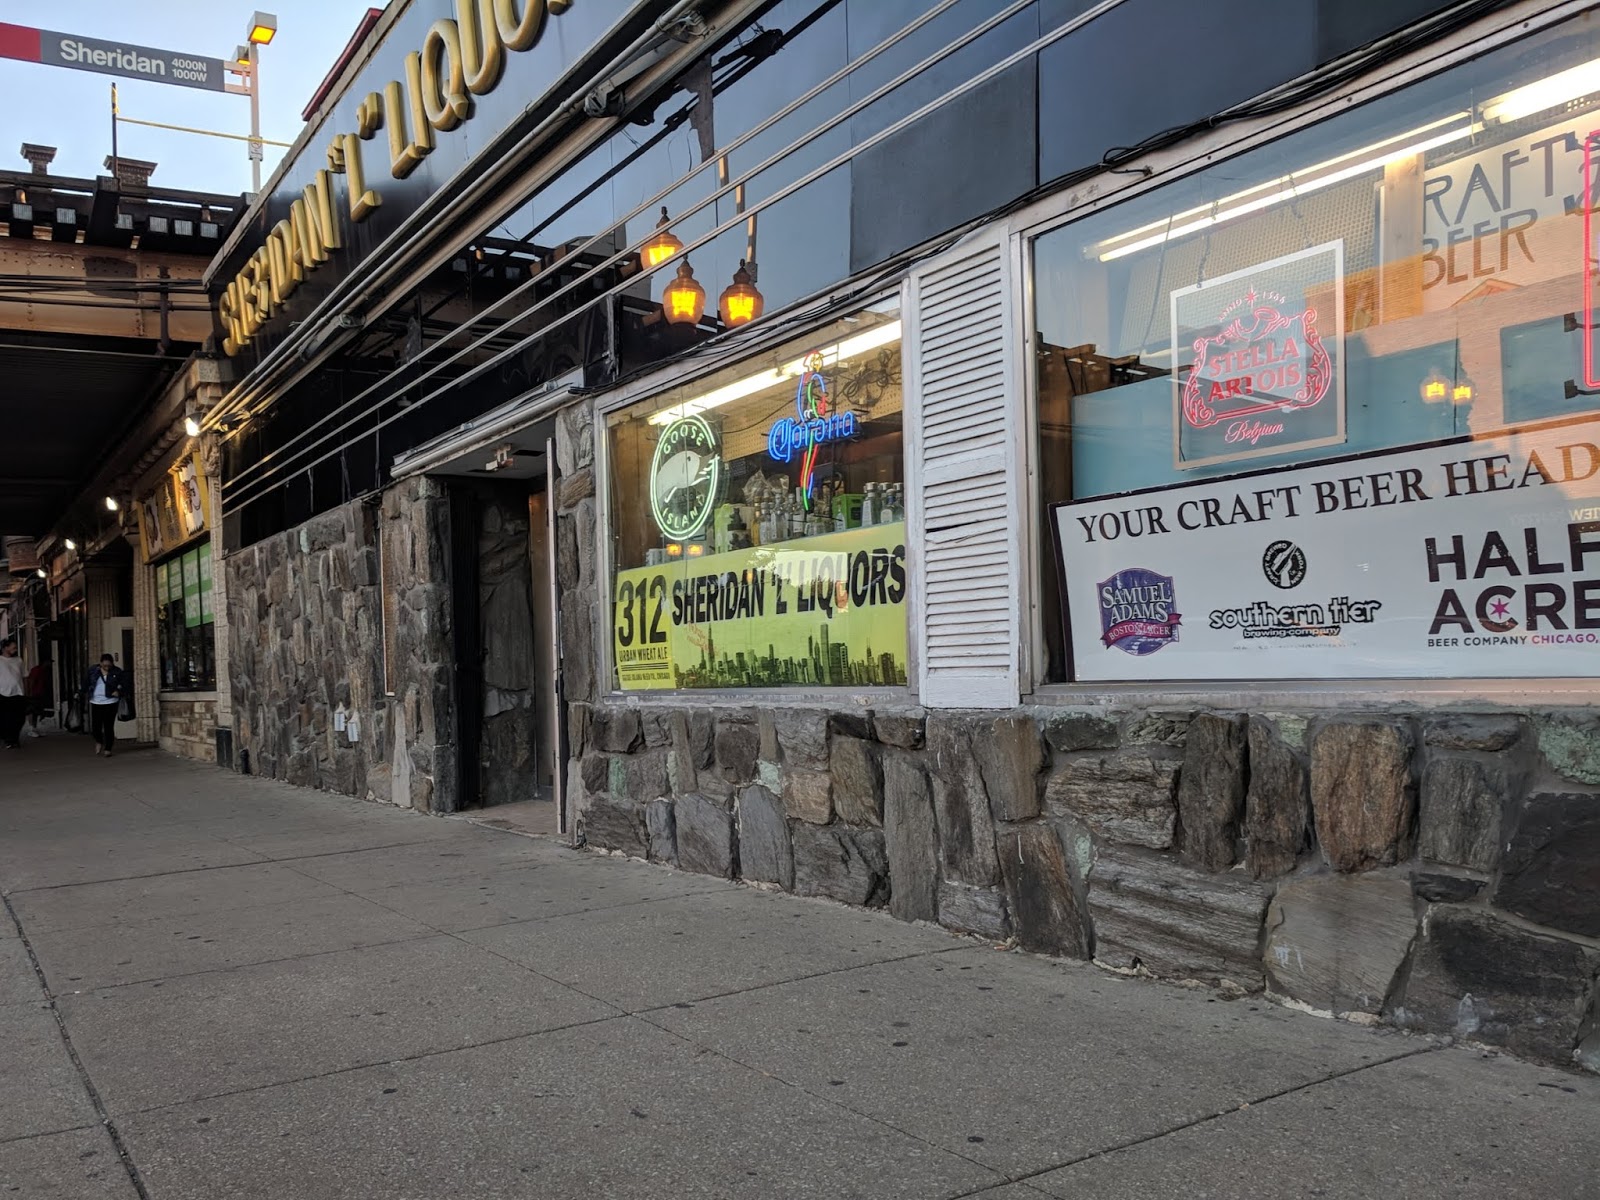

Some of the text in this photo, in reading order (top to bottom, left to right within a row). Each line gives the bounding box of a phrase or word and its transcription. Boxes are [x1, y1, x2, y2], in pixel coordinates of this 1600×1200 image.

[60, 38, 166, 77] Sheridan
[171, 57, 207, 73] 4000N
[171, 69, 208, 83] 1000W
[1208, 337, 1300, 378] STELLA
[1207, 362, 1302, 402] ARTOIS
[663, 424, 705, 455] GOOSE
[767, 410, 855, 464] Corona
[1224, 419, 1284, 445] Belgium
[1077, 441, 1600, 543] YOUR CRAFT BEER HEAD
[662, 493, 706, 529] ISLAND
[1424, 520, 1600, 583] HALF
[671, 567, 765, 626] SHERIDAN
[797, 544, 906, 619] LIQUORS
[1101, 581, 1173, 609] SAMUEL
[618, 573, 667, 648] 312
[1109, 601, 1169, 627] ADAMS
[1208, 595, 1383, 630] southern tier
[1427, 579, 1600, 635] ACRE
[1108, 623, 1172, 641] BOSTON LAGER
[1243, 625, 1341, 639] brewing company
[1427, 632, 1599, 648] BEER COMPANY CHICAGO,
[619, 646, 668, 662] URBAN WHEAT ALE
